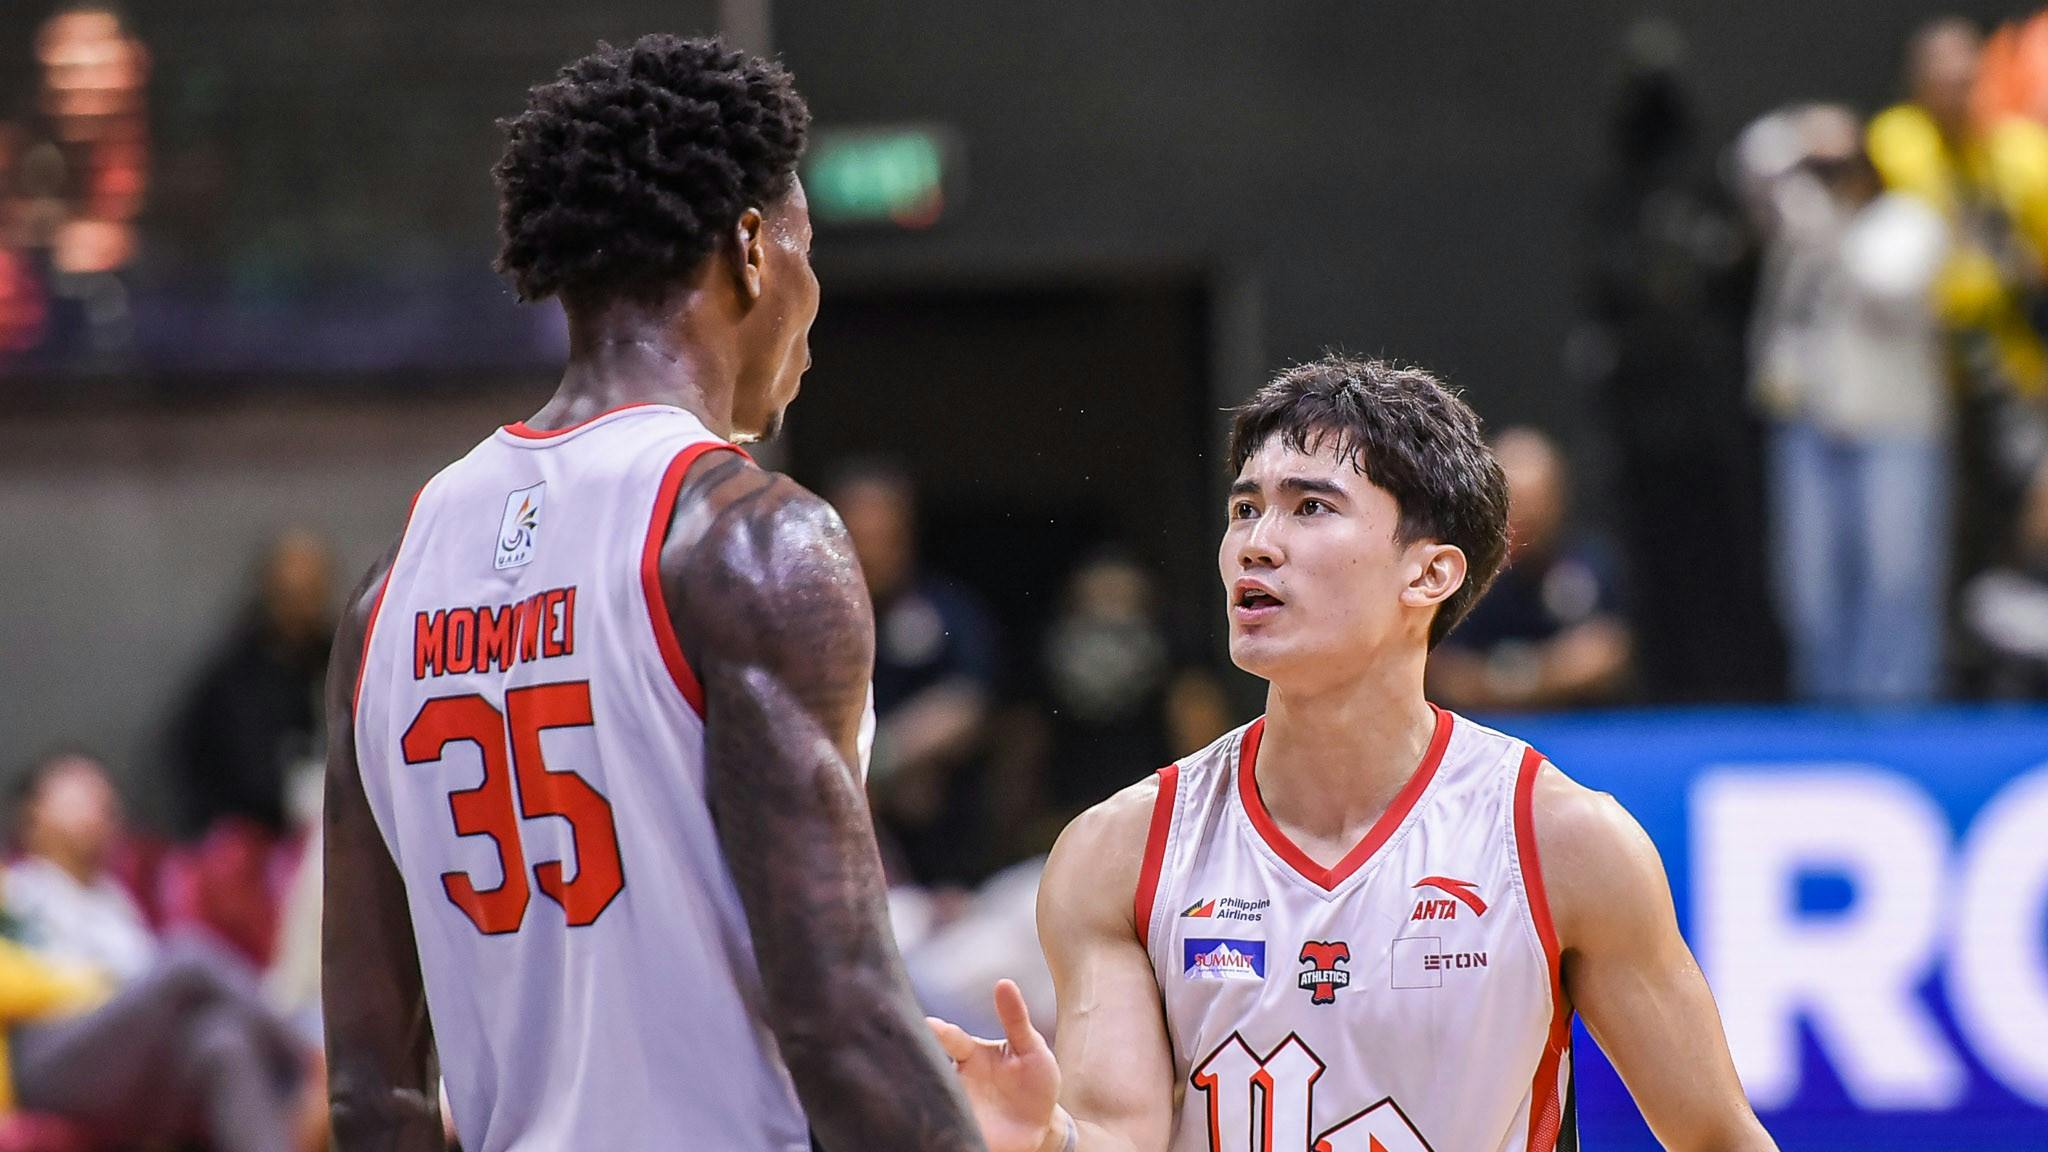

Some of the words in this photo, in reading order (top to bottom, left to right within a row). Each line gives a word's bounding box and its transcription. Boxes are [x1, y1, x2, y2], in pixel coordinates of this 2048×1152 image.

[401, 680, 625, 935] 35
[1216, 909, 1262, 921] Airlines
[1411, 900, 1457, 921] ANTA
[1194, 952, 1255, 969] SUMMIT
[1424, 952, 1488, 970] ETON
[1300, 969, 1348, 986] ATHLETICS
